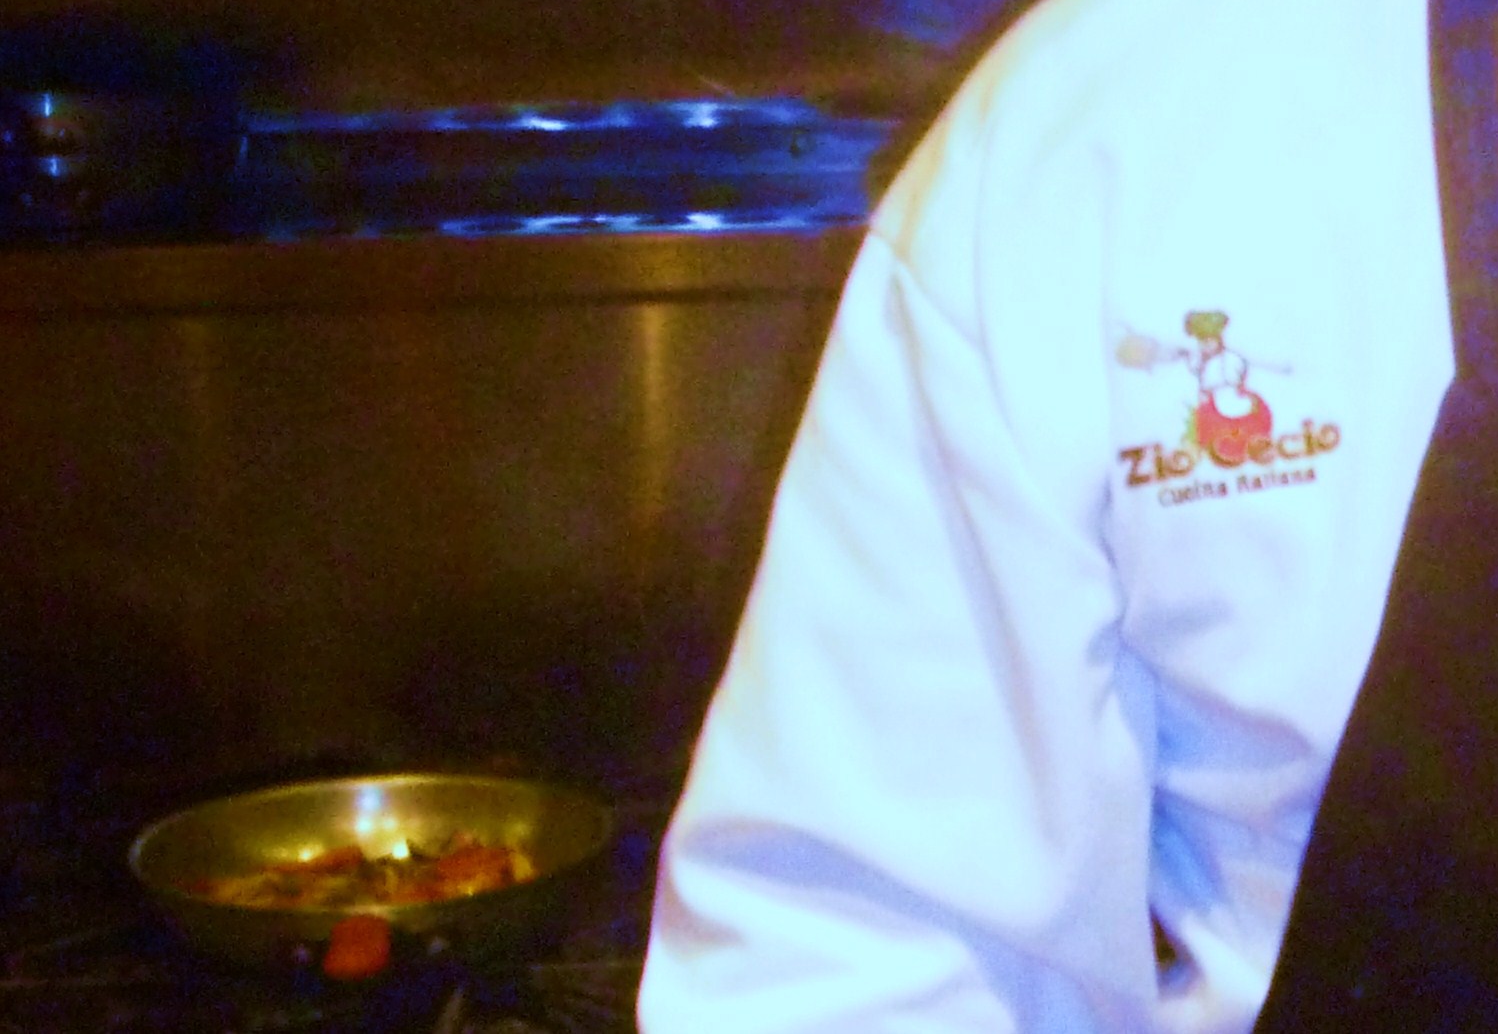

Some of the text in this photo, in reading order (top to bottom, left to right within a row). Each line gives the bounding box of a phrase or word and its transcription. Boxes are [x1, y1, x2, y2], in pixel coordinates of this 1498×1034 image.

[1119, 419, 1340, 487] Zio Cecio
[1159, 468, 1316, 508] Cucina Italiana
